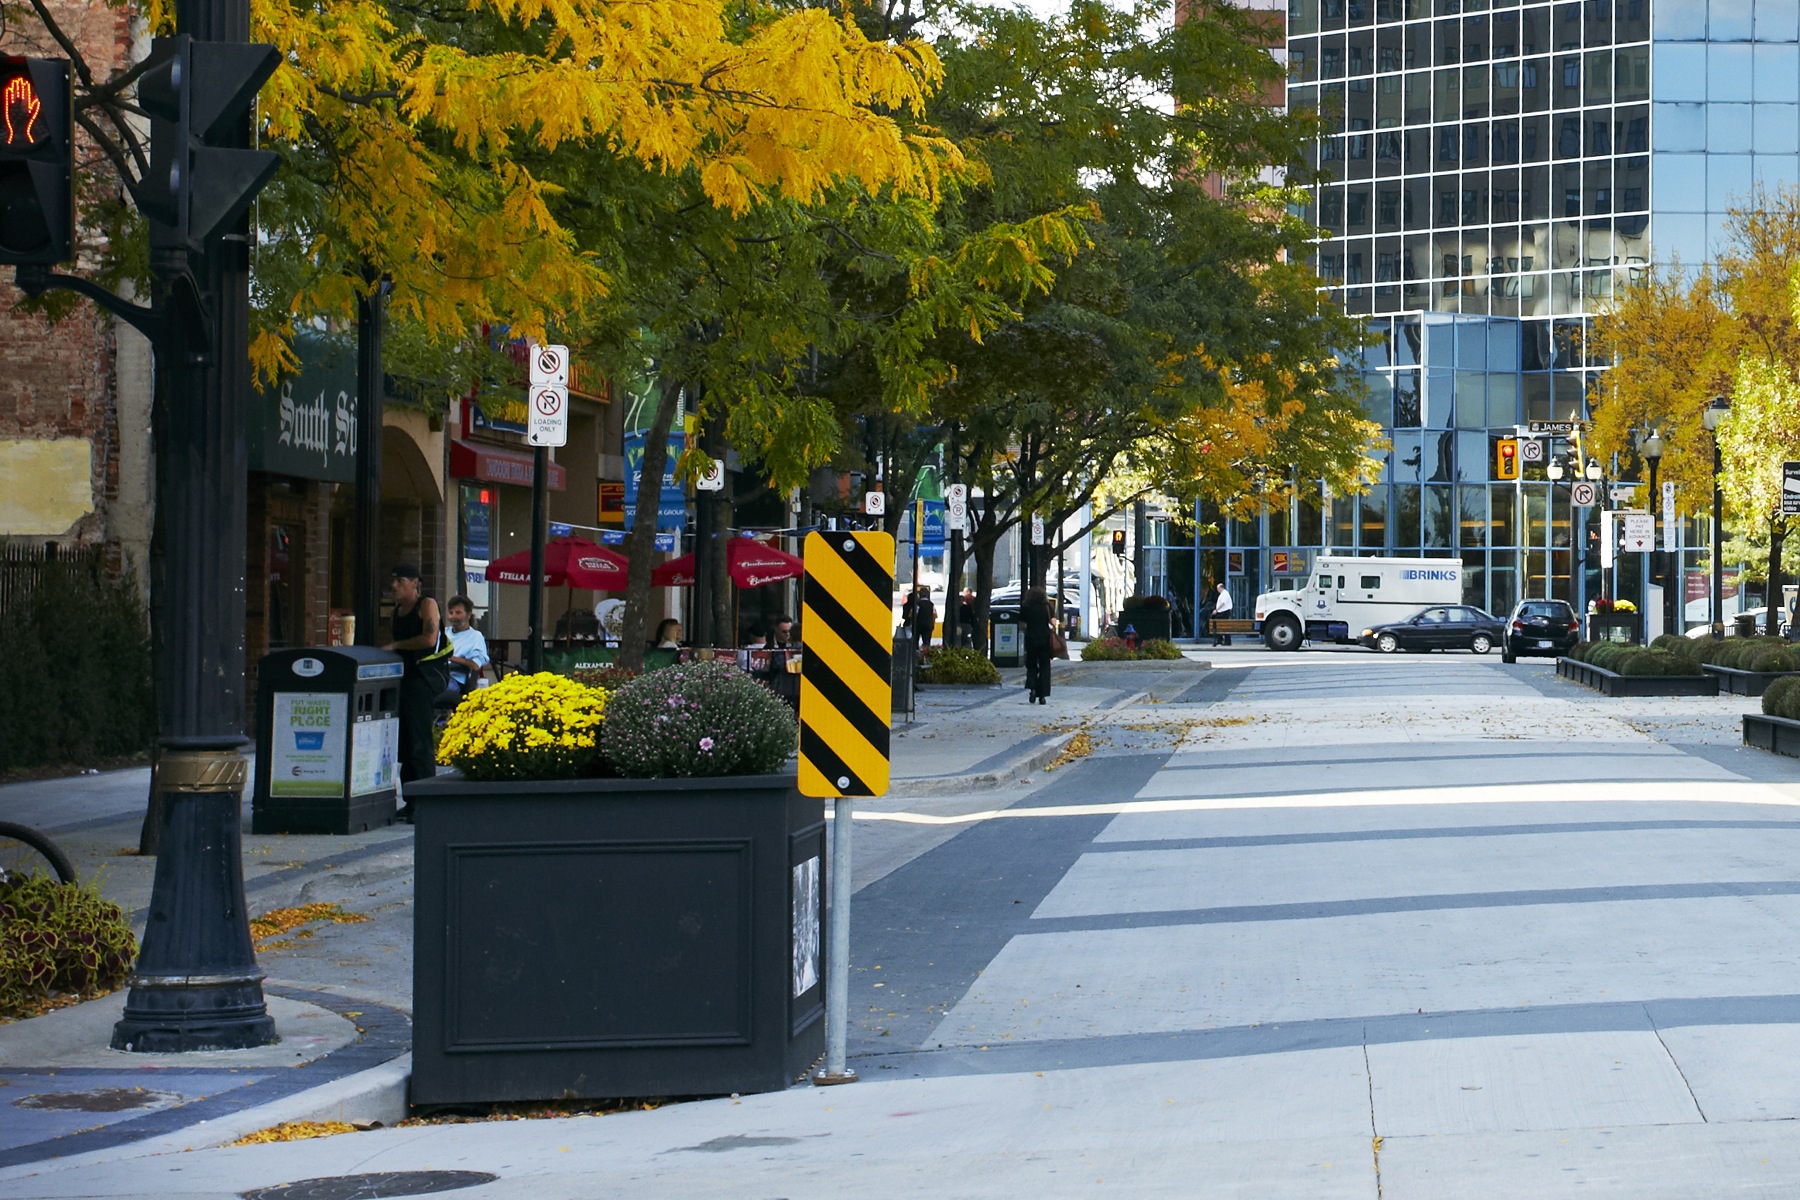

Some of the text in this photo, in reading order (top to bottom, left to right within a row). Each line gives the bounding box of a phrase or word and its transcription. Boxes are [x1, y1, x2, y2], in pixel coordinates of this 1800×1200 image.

[279, 380, 330, 468] South
[533, 418, 562, 426] LOADING
[1540, 422, 1572, 431] JAMES
[499, 571, 525, 581] STELLA
[1409, 569, 1457, 581] BRINKS
[294, 706, 331, 715] RIGHT
